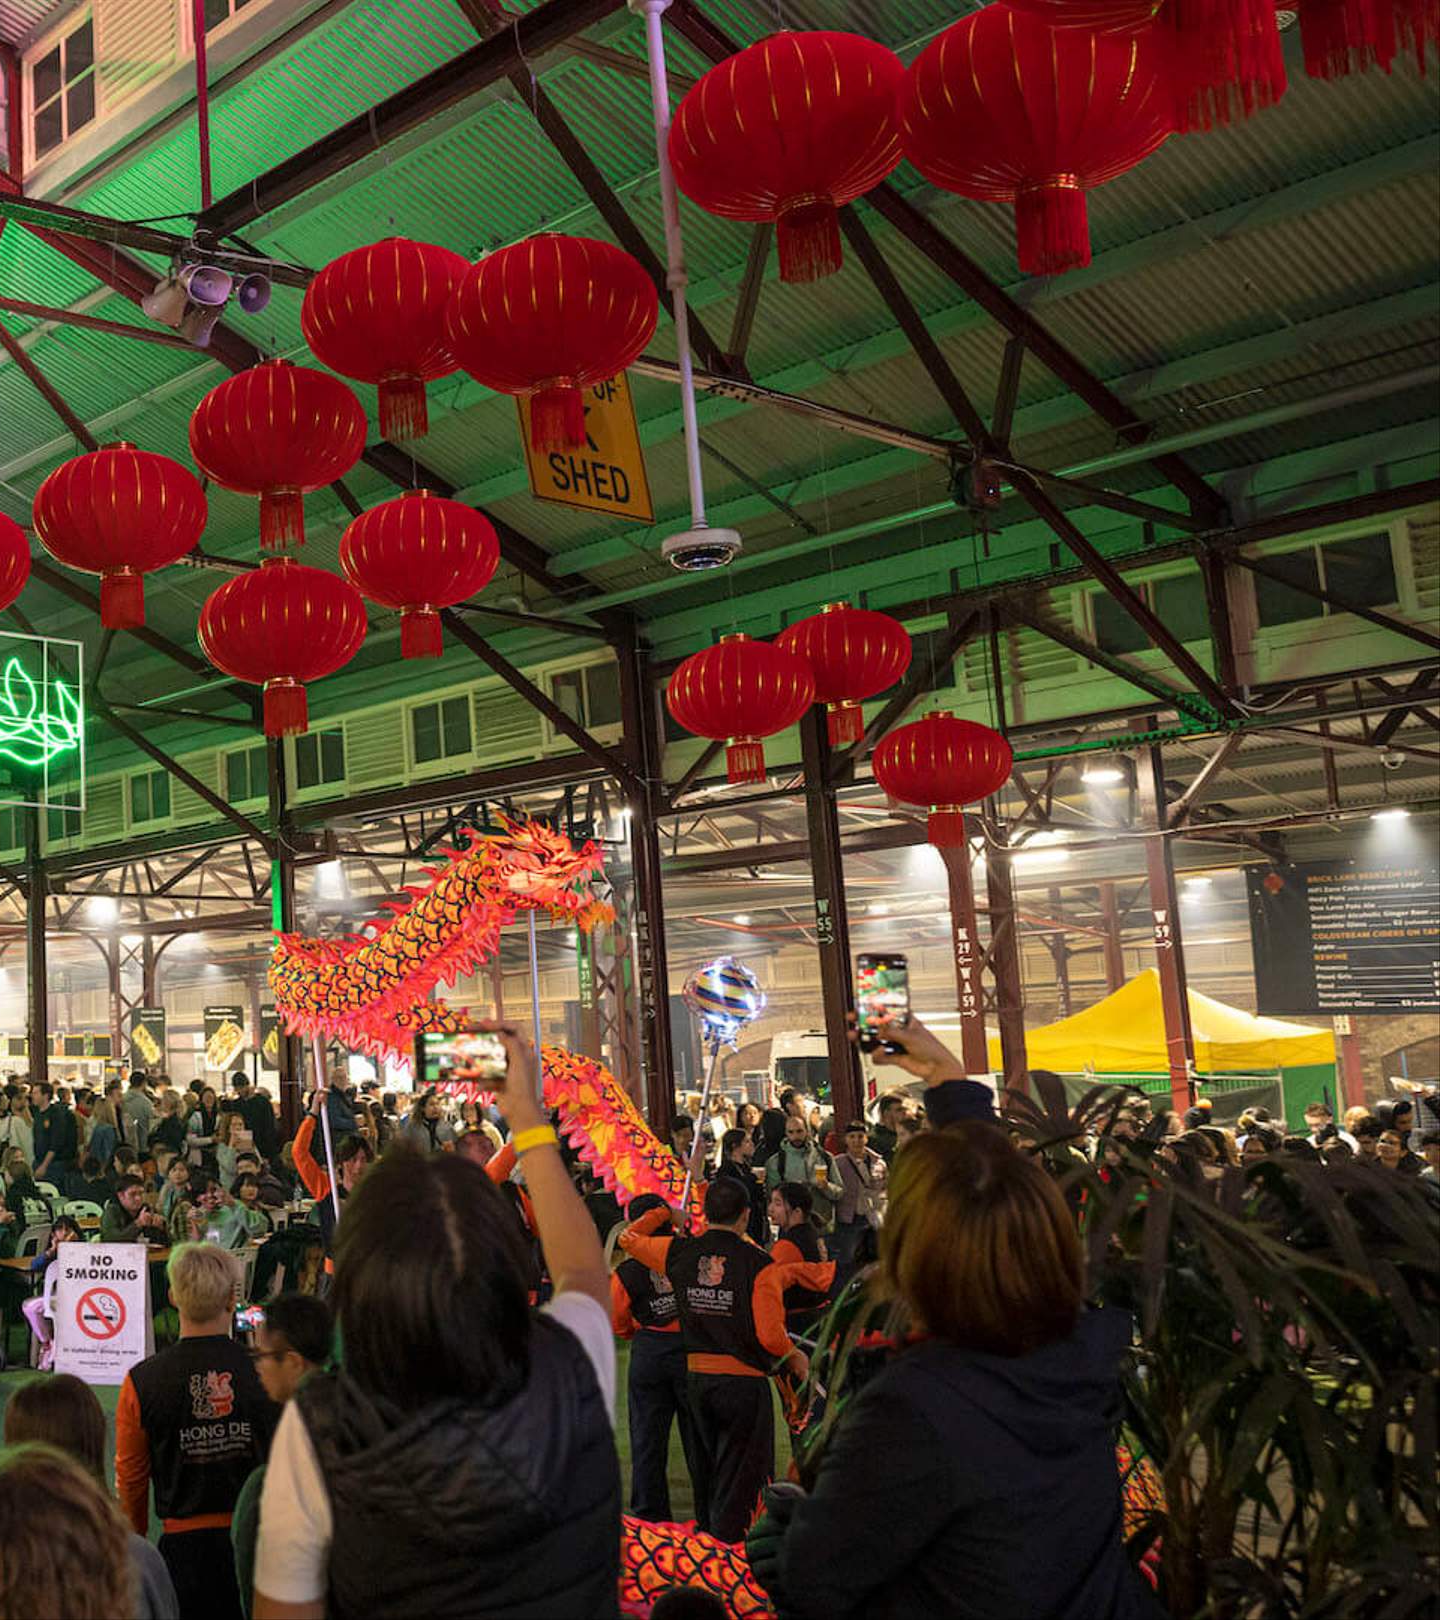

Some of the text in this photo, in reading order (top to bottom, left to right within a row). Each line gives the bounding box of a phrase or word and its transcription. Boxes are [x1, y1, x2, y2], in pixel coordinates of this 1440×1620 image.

[548, 452, 630, 504] SHED
[90, 1255, 113, 1267] NO
[65, 1268, 138, 1281] SMOKING
[687, 1287, 734, 1301] HONG DE
[179, 1422, 252, 1442] HONG DE
